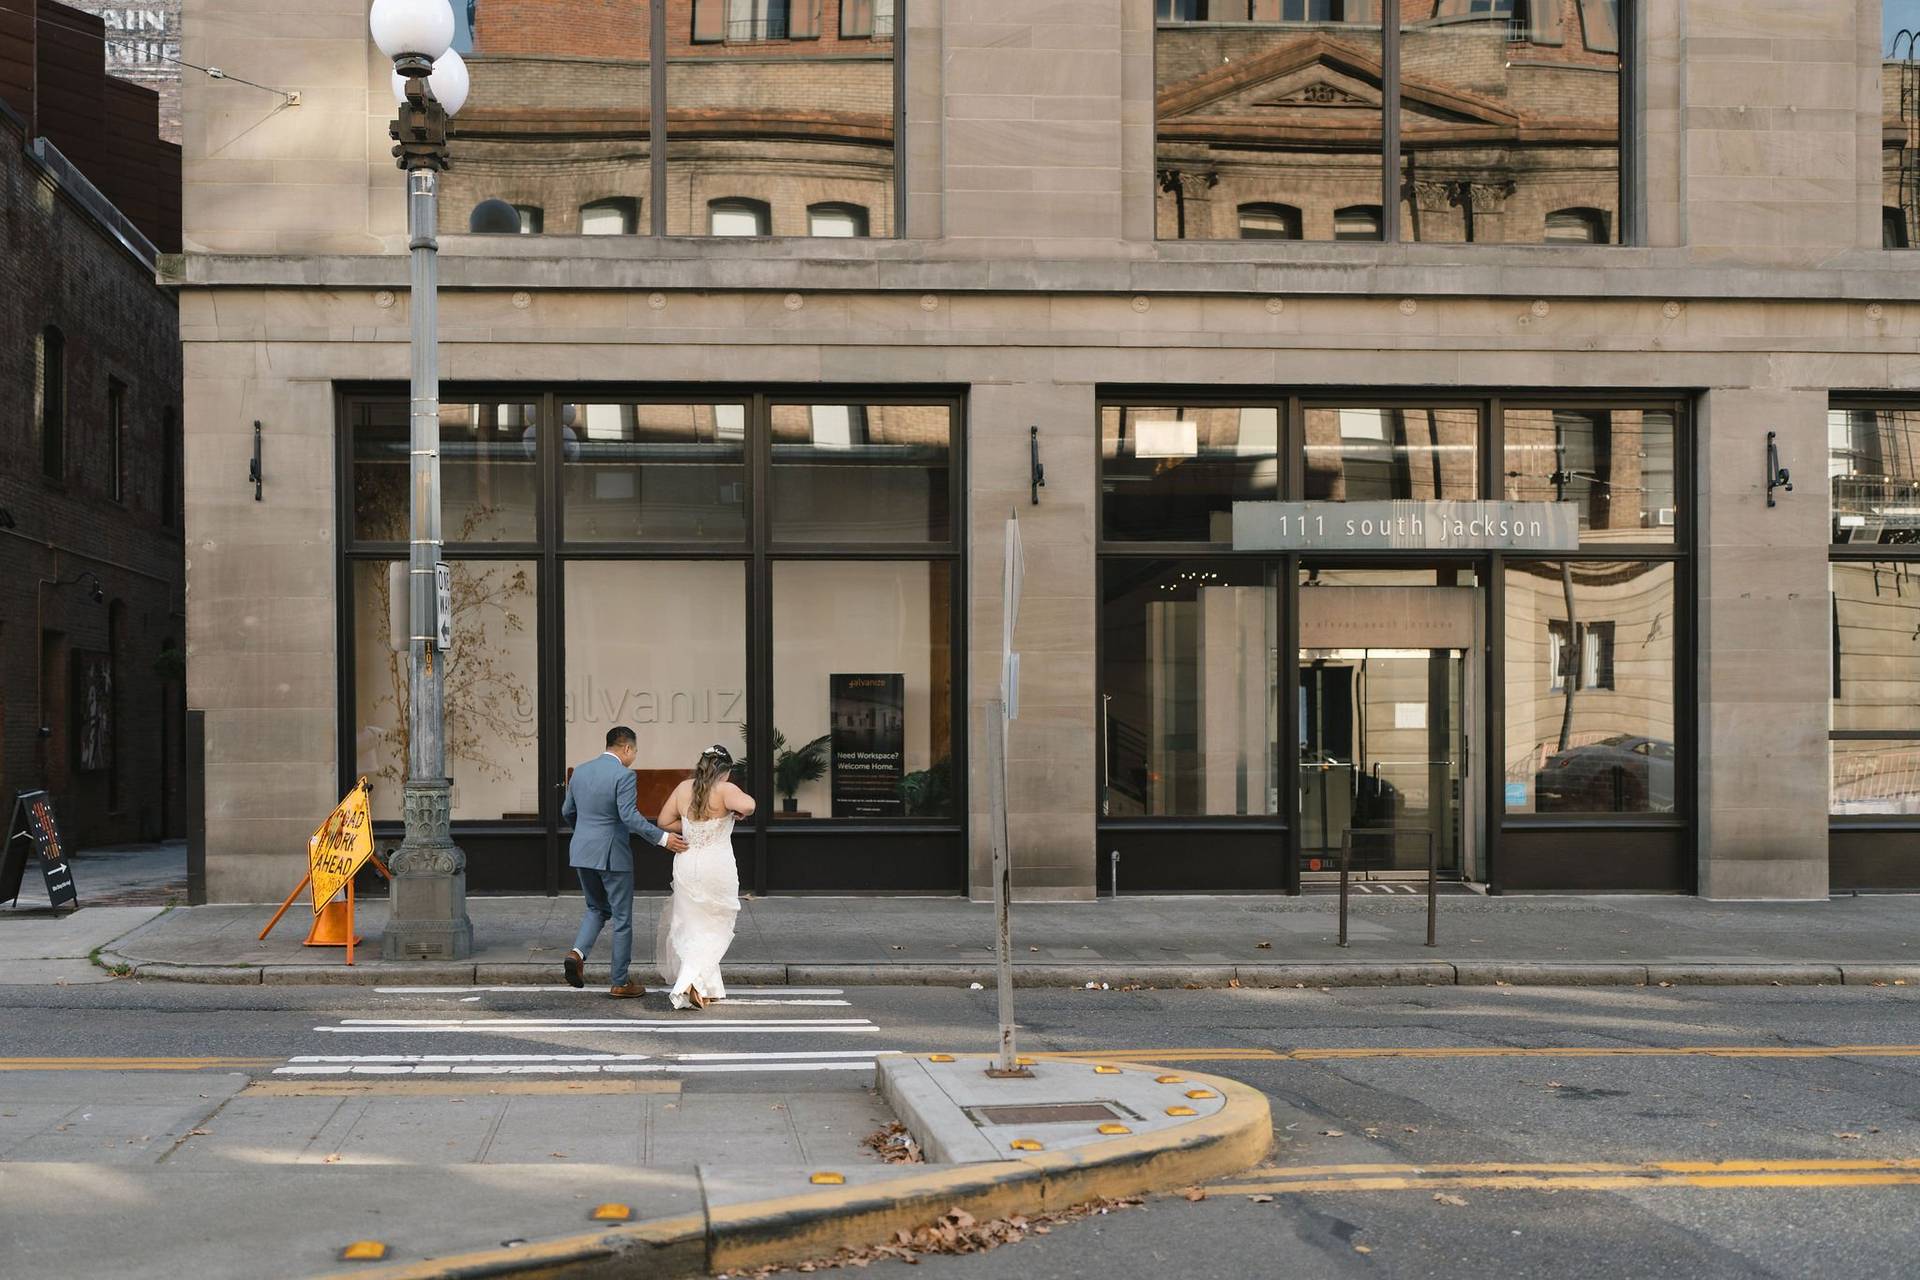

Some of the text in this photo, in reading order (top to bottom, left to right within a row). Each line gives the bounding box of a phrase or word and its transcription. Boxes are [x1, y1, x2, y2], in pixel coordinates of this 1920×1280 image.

[85, 8, 164, 31] AIN
[1279, 513, 1541, 541] 111 south jackson
[837, 751, 899, 761] Need Workspace?
[837, 762, 870, 770] Welcome
[313, 853, 352, 875] AHEAD
